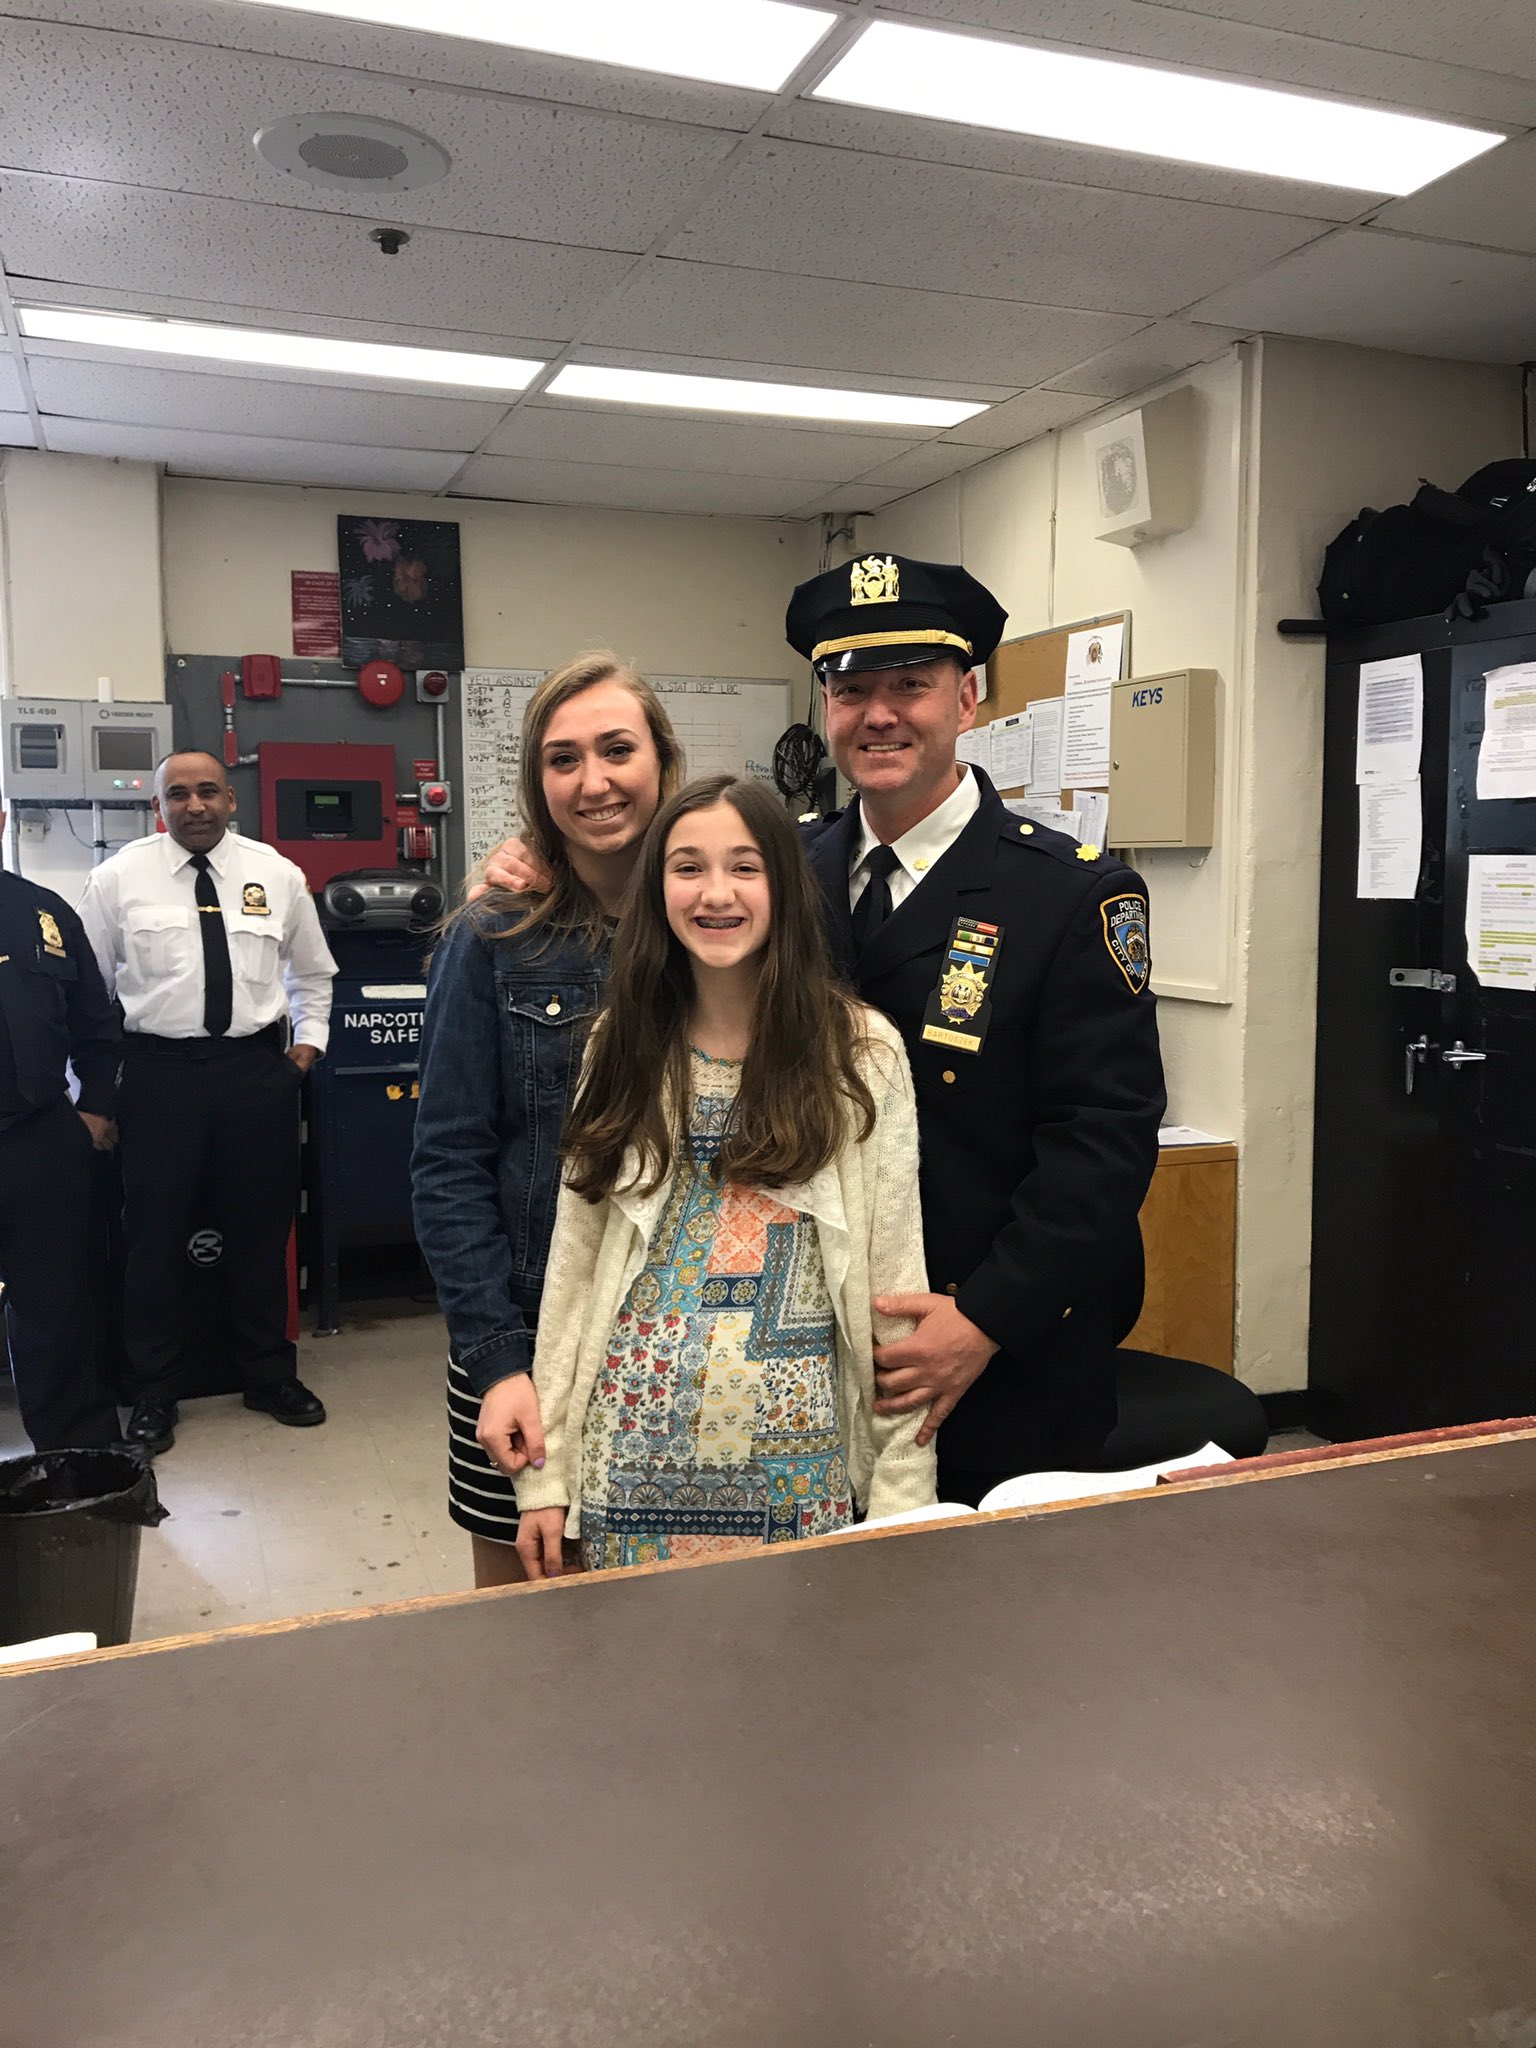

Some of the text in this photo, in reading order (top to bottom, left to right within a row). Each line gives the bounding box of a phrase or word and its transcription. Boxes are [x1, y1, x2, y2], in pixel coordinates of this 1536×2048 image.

[1131, 686, 1163, 708] KEYS
[1118, 900, 1142, 912] POLICE
[1111, 939, 1127, 962] CITY
[1125, 963, 1136, 977] OF
[370, 1028, 419, 1044] SAFE
